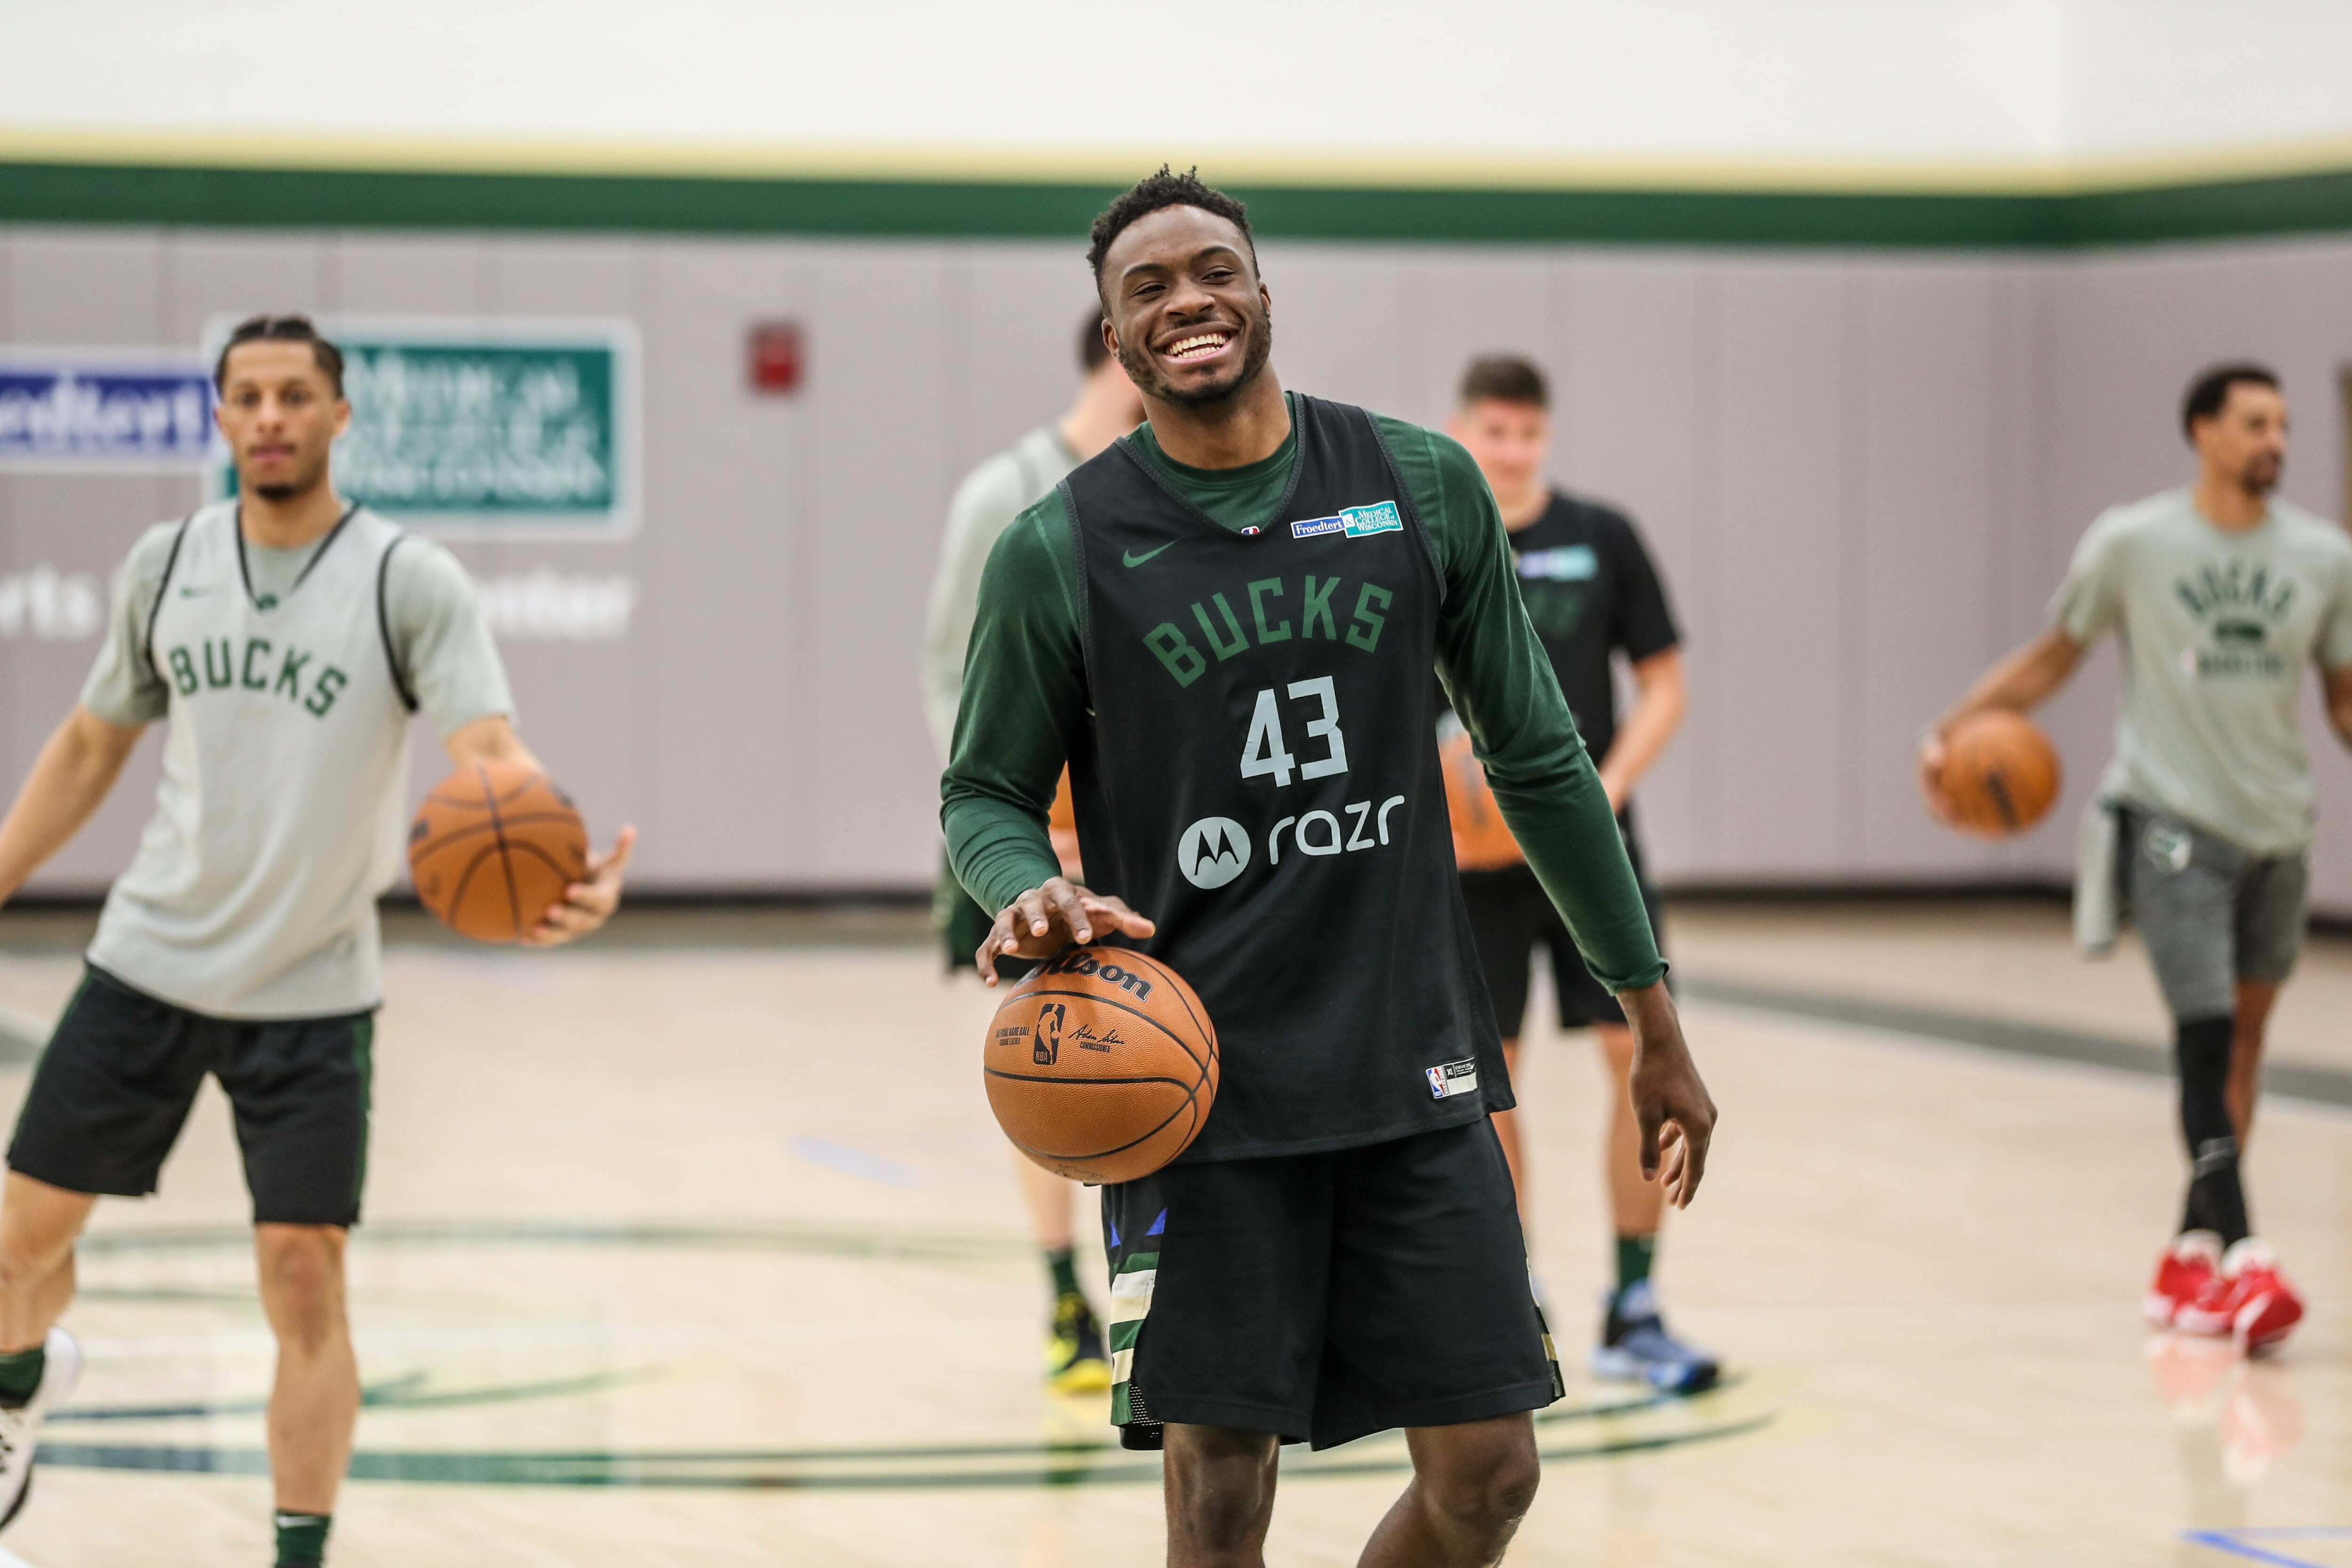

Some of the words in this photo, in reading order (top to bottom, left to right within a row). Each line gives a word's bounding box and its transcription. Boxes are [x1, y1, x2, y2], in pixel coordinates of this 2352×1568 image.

[1355, 513, 1391, 525] COLLEGE
[1358, 507, 1393, 519] MEDICAL
[1295, 520, 1343, 535] Froedtert
[1356, 519, 1398, 532] WISCONSIN
[1143, 575, 1393, 688] BUCKS
[169, 637, 349, 719] BUCKS
[1240, 675, 1349, 788] 43
[1269, 795, 1405, 865] razr
[1019, 1027, 1030, 1035] BALL
[1080, 1042, 1111, 1053] COMMISSIONER
[1036, 1051, 1047, 1061] NBA
